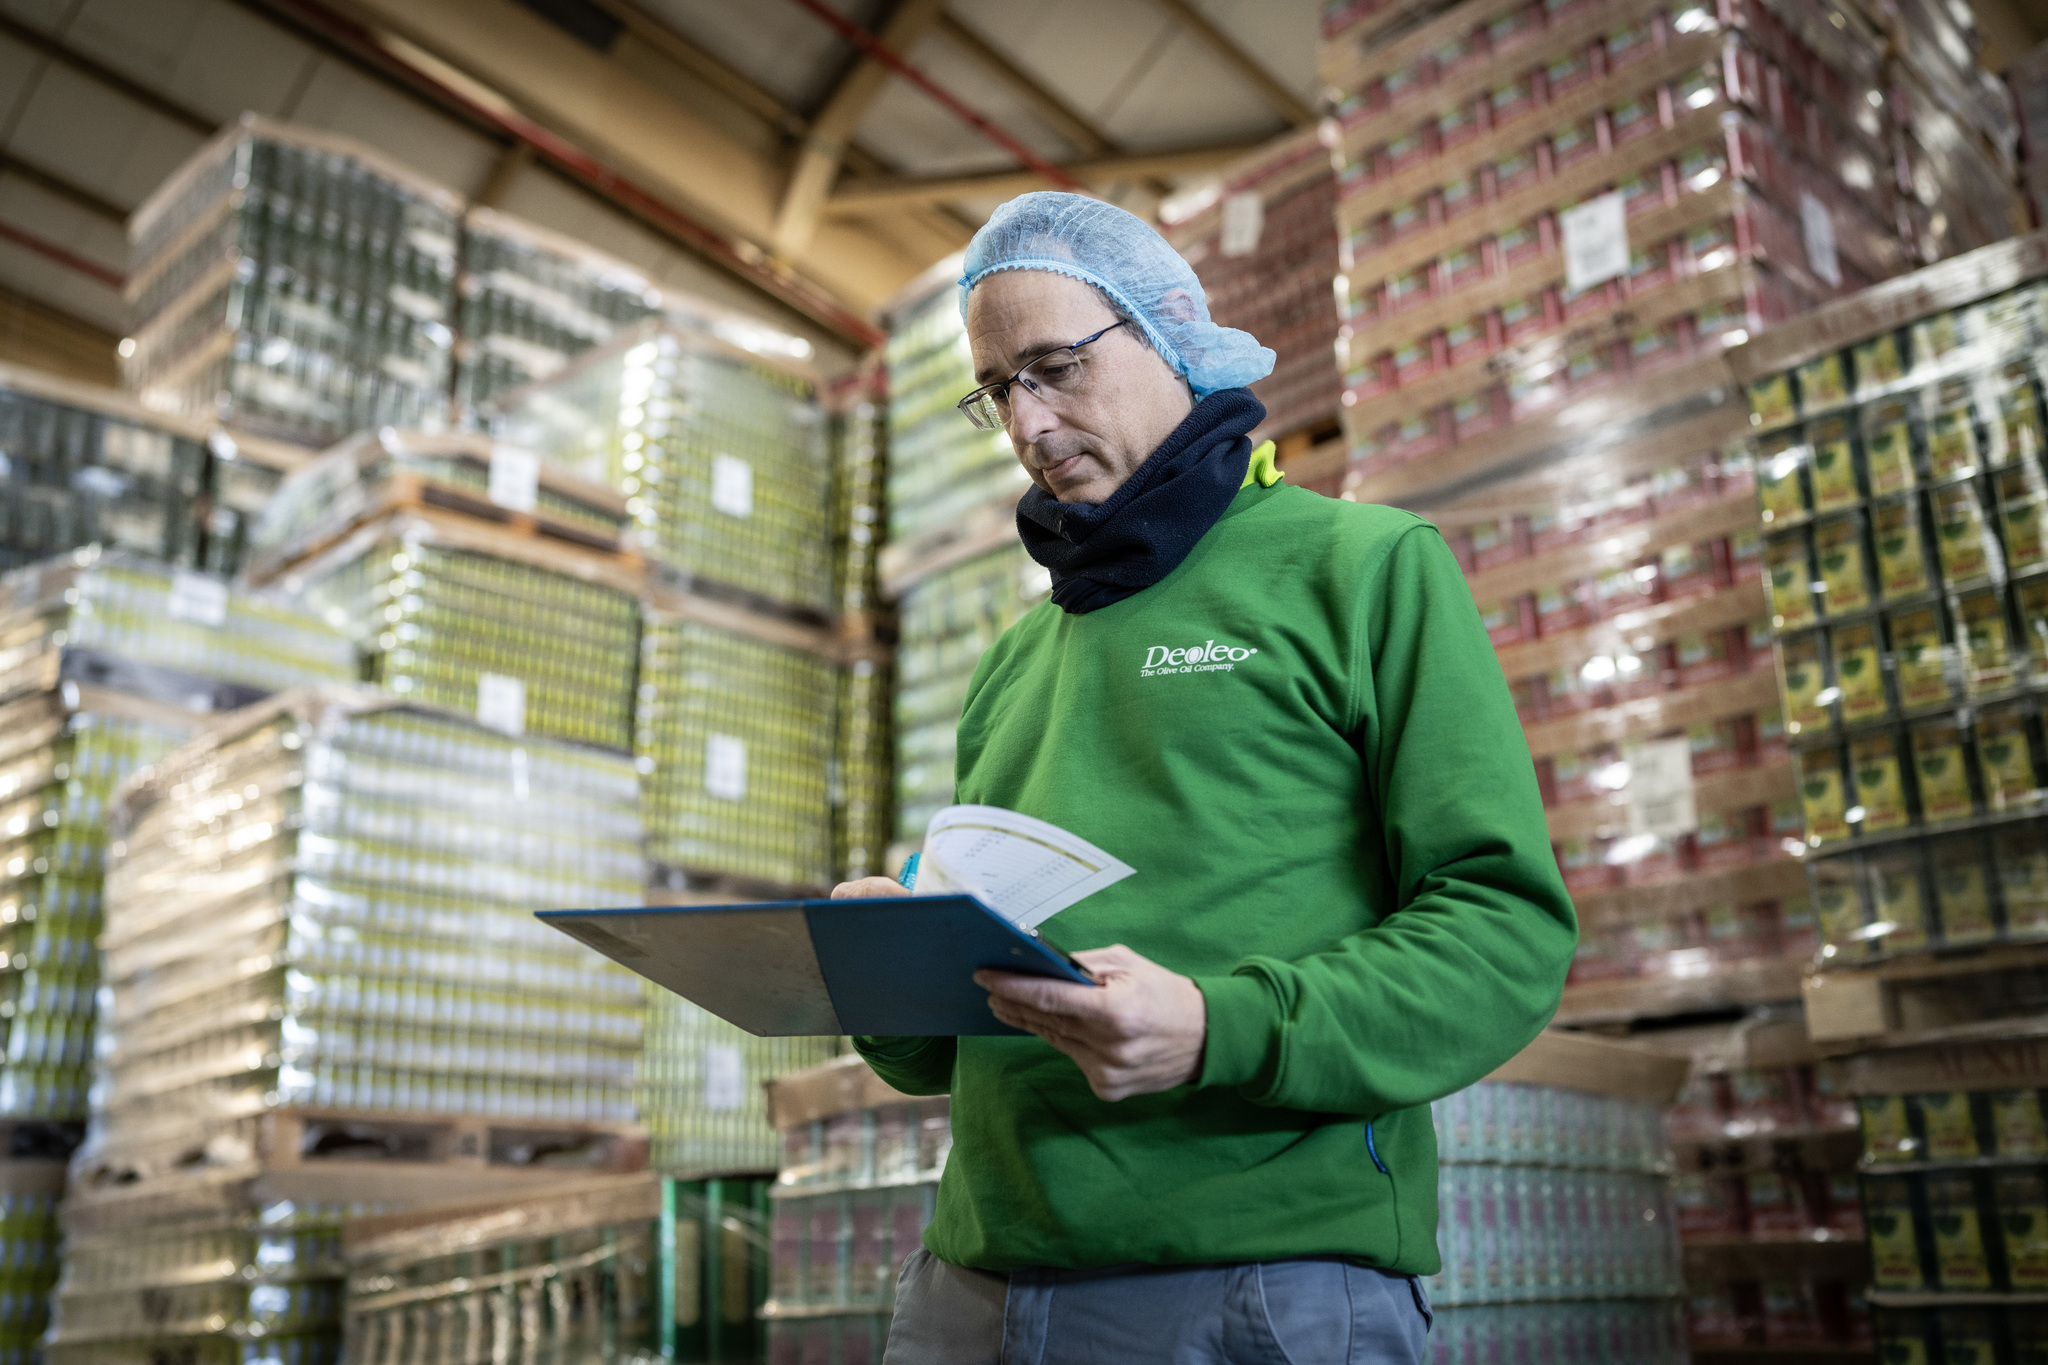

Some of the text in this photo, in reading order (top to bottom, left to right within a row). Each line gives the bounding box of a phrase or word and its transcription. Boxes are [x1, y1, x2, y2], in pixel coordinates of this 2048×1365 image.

[1141, 640, 1258, 669] Deoleo
[1140, 663, 1235, 677] The Olive Oil Company.
